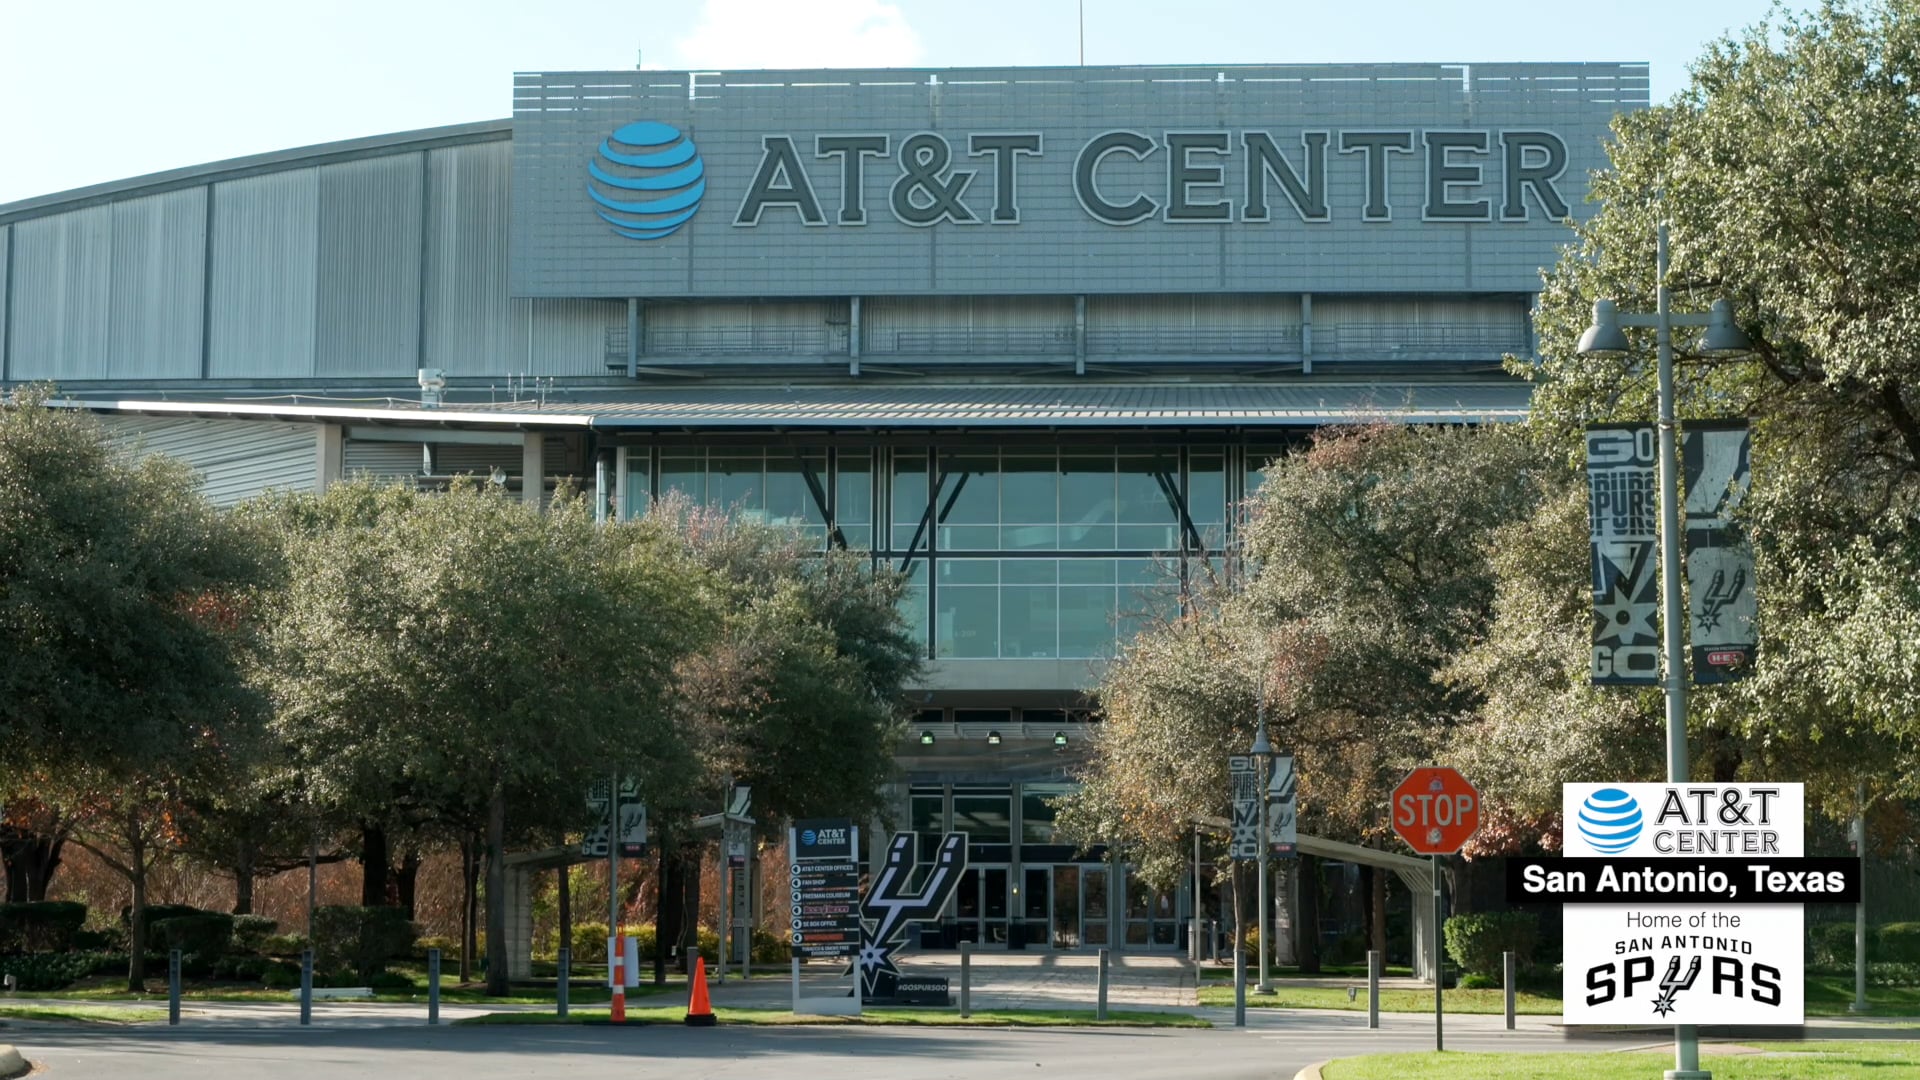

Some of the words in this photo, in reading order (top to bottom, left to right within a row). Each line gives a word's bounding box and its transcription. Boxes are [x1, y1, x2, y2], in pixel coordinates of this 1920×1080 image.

[732, 132, 1044, 229] AT&T
[1073, 130, 1572, 224] CENTER
[1592, 645, 1658, 679] GO
[1398, 794, 1474, 827] STOP
[818, 828, 846, 838] AT&T
